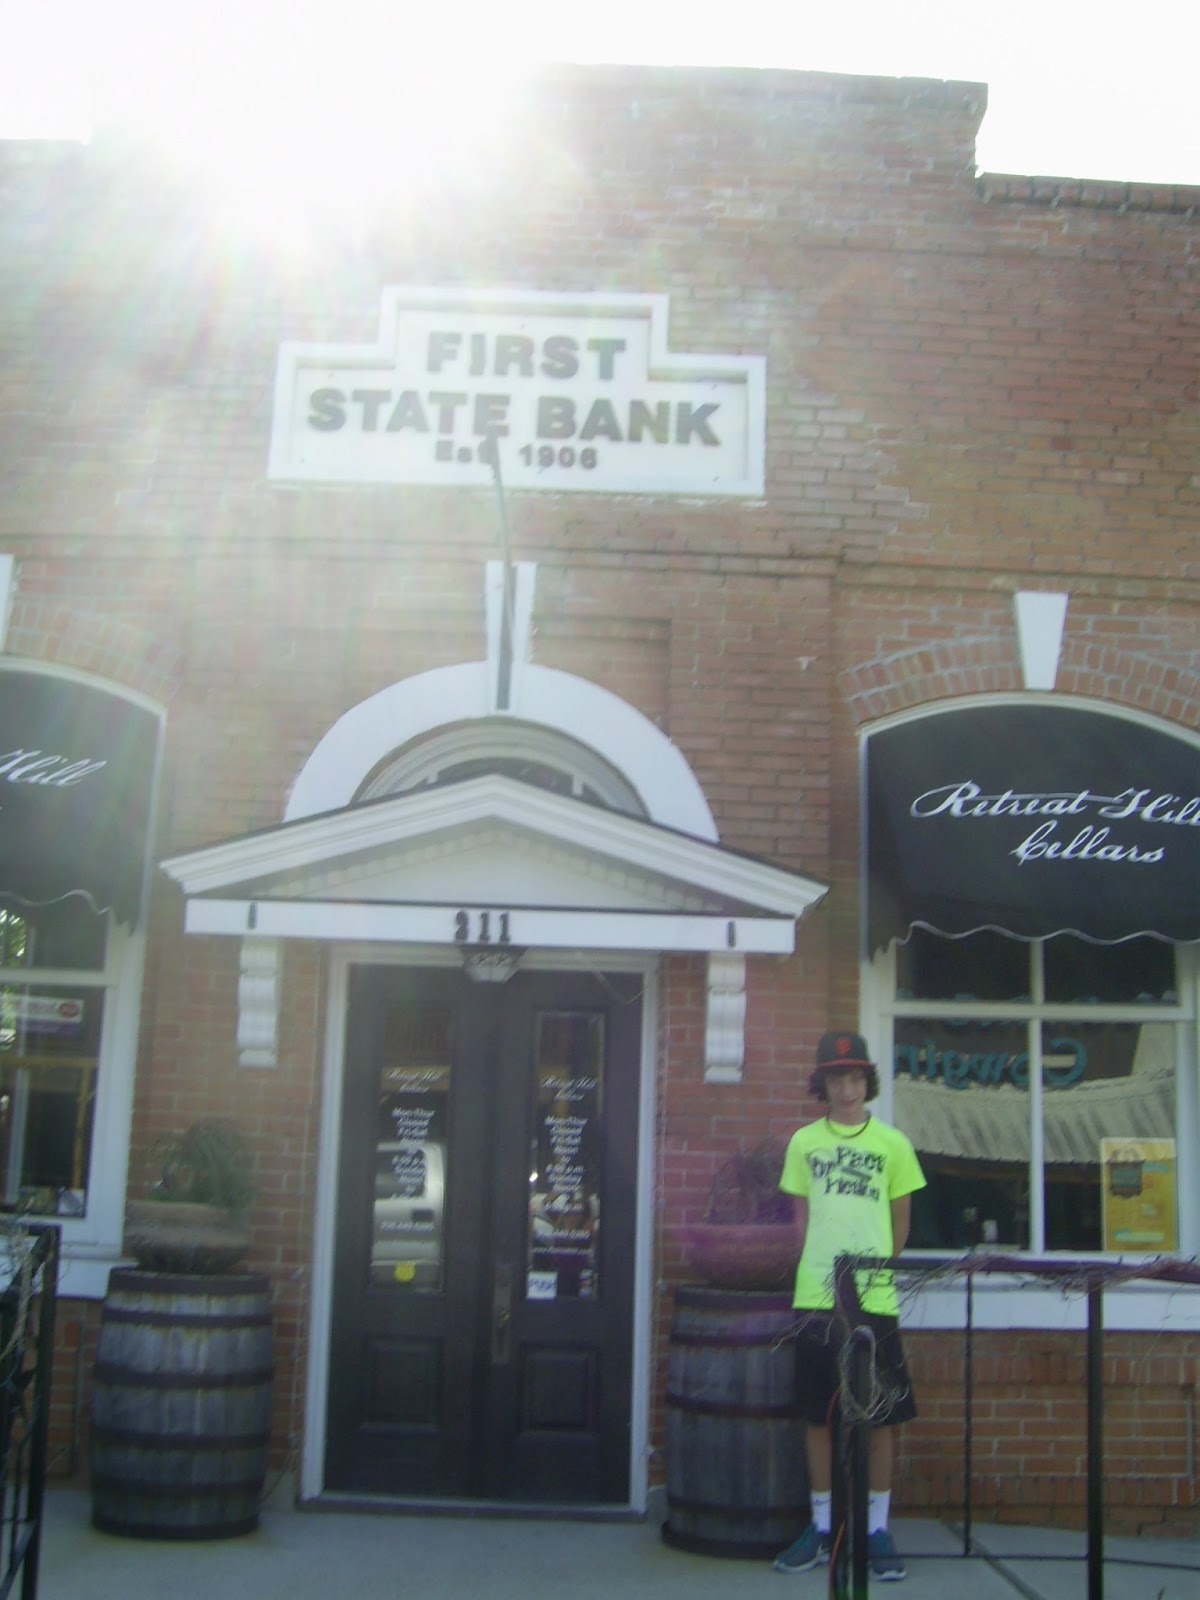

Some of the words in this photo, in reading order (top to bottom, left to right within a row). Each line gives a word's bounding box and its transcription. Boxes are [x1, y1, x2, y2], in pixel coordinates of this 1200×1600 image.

[426, 331, 627, 381] FIRST
[306, 387, 511, 438] STATE
[536, 396, 721, 447] BANK
[910, 780, 1112, 818] Retreat
[1009, 820, 1166, 867] Cellars
